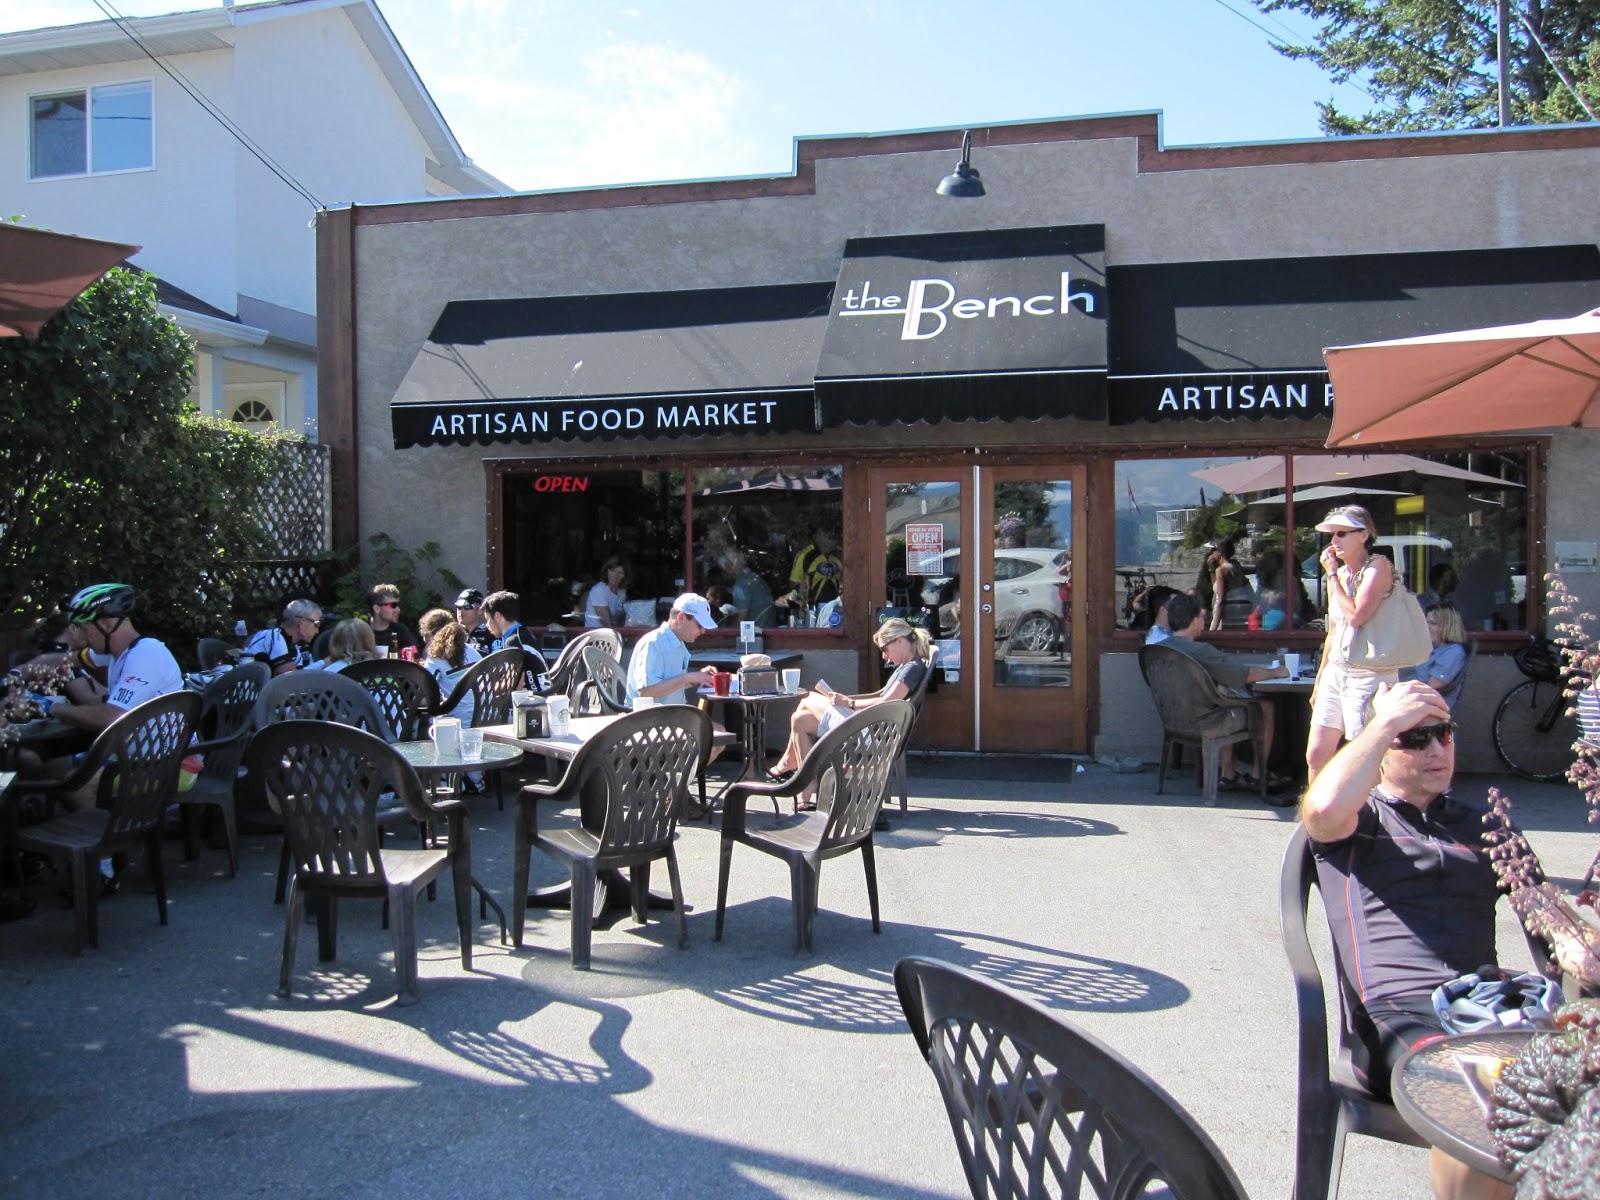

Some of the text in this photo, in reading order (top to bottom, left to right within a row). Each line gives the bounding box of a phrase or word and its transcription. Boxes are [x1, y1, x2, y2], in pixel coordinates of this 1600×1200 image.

[841, 271, 1094, 341] the Bench
[1157, 383, 1307, 411] ARTISAN
[430, 401, 778, 437] ARTISAN FOOD MARKET
[534, 476, 589, 493] OPEN
[911, 532, 938, 543] OPEN
[113, 688, 134, 704] 2013
